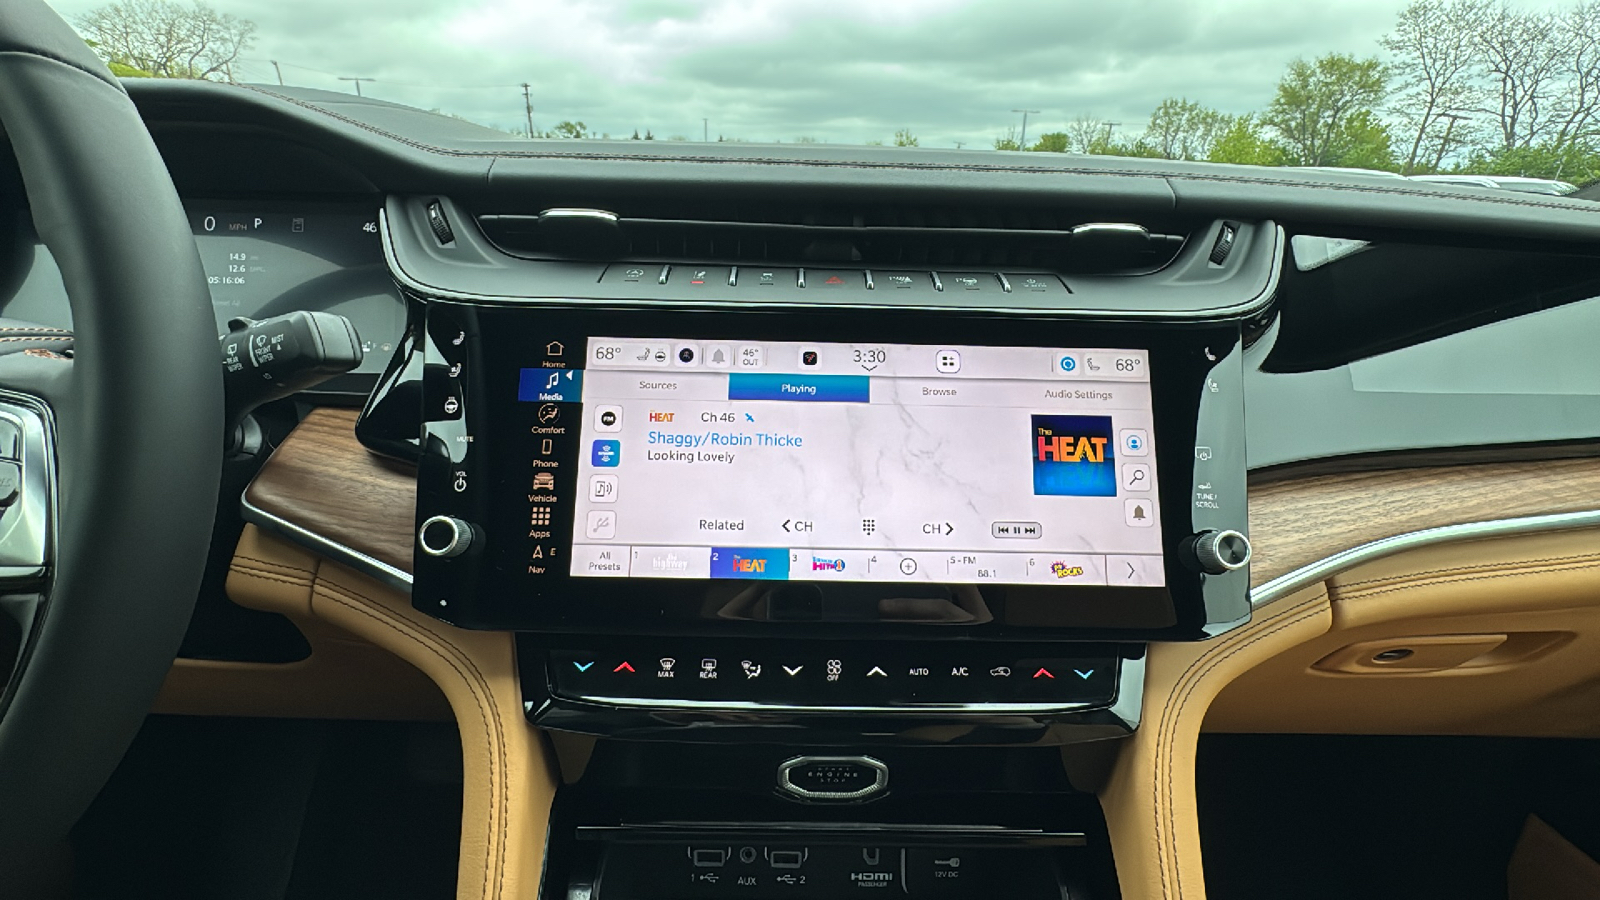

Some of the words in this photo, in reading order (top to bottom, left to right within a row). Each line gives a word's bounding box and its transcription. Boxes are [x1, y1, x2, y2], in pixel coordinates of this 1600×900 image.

[204, 216, 216, 232] 0
[229, 223, 248, 231] MPH
[254, 218, 263, 229] P
[362, 222, 378, 233] 46
[229, 253, 247, 261] 14.9
[228, 264, 246, 273] 12.6
[208, 276, 246, 285] 05:16:06
[271, 333, 284, 344] MIST
[226, 356, 239, 365] REAR
[853, 349, 887, 363] 3:30
[542, 360, 566, 369] Home
[742, 358, 759, 366] OUT
[639, 380, 678, 390] Sources
[781, 383, 817, 395] Playing
[922, 387, 957, 396] Browse
[1044, 389, 1073, 399] Audio
[1074, 390, 1113, 401] Settings
[539, 392, 563, 401] Media
[602, 415, 615, 423] FM
[649, 412, 675, 422] HEAT
[700, 412, 717, 422] Ch
[719, 412, 736, 423] 46
[531, 426, 566, 434] Comfort
[1037, 427, 1053, 436] The
[456, 435, 474, 443] MUTE
[647, 431, 753, 447] Shaggy/Robin
[755, 434, 803, 447] Thicke
[1037, 436, 1108, 463] HEAT
[647, 450, 694, 463] Looking
[697, 451, 736, 464] Lovely
[532, 459, 559, 468] Phone
[528, 494, 558, 503] Vehicle
[1195, 501, 1219, 509] SCROLL
[699, 519, 745, 531] Related
[794, 521, 813, 532] CH
[922, 523, 941, 534] CH
[528, 529, 551, 539] Apps
[550, 547, 557, 556] E
[599, 551, 611, 560] All
[712, 553, 719, 561] 2
[870, 556, 877, 564] 4
[950, 556, 956, 564] 5
[963, 557, 977, 565] FM
[588, 561, 621, 571] Presets
[652, 557, 688, 571] highway
[732, 558, 767, 572] HEAT
[528, 565, 546, 574] Nav
[1056, 566, 1084, 578] ROCKS
[699, 671, 717, 679] REAR
[909, 668, 929, 676] AUTO
[951, 667, 969, 676] A/C
[691, 874, 695, 882] 1
[737, 876, 757, 885] AUX
[799, 876, 806, 884] 2
[851, 873, 893, 881] HDMI
